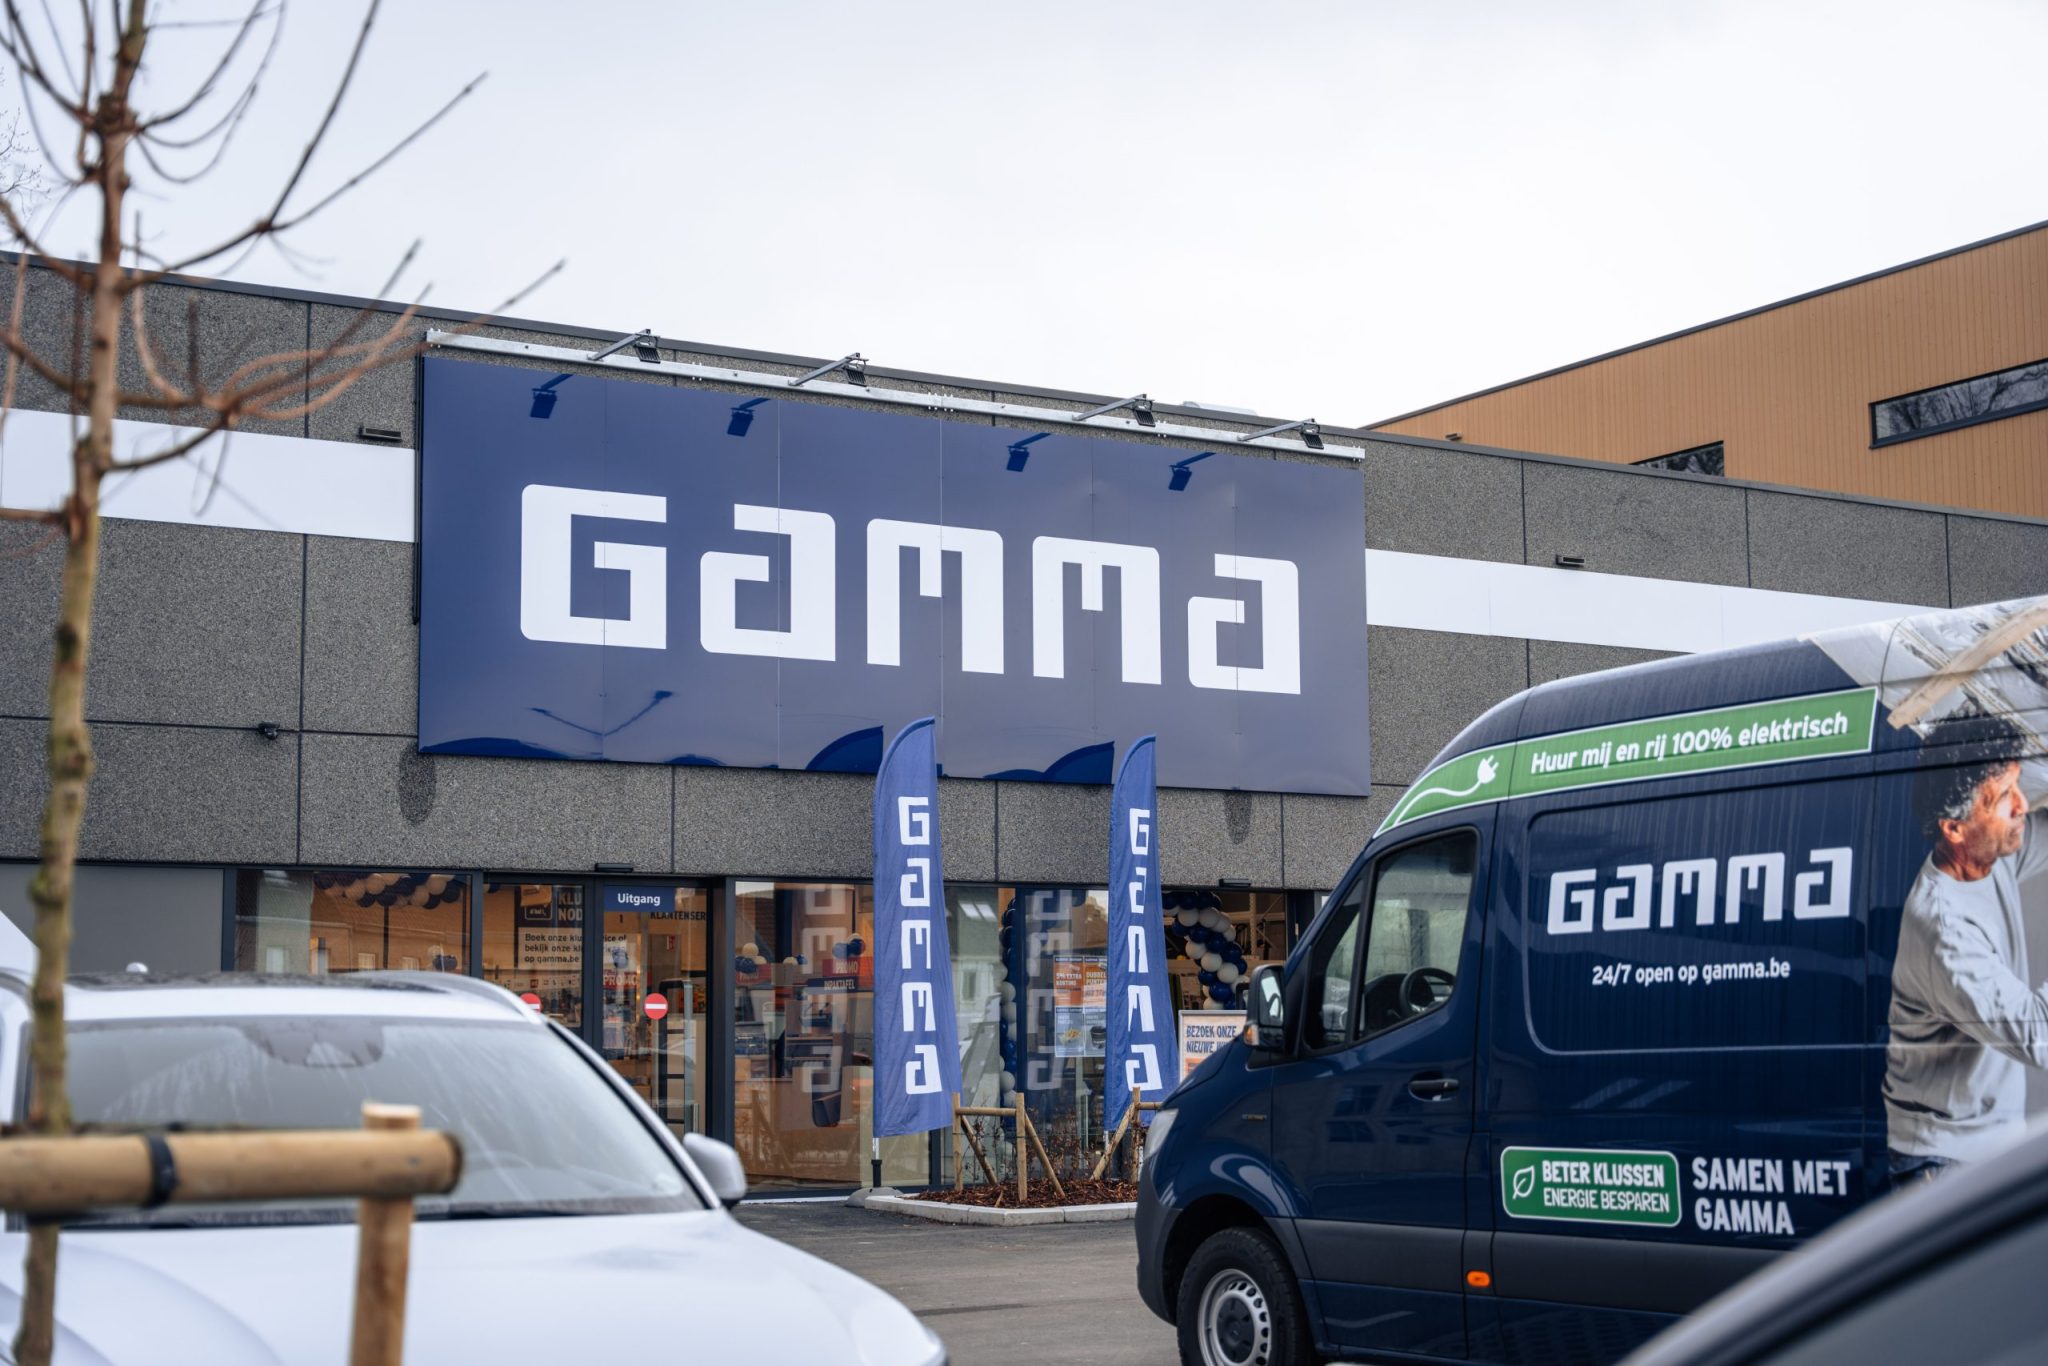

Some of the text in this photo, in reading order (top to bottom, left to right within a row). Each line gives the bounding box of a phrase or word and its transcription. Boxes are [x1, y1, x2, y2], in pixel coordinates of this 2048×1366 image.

[520, 484, 1301, 694] GAMMA
[1531, 711, 1848, 774] Huur mij en rij 100% elektrisch
[617, 893, 661, 907] Uitgang
[1547, 846, 1852, 935] GAMMA
[525, 933, 546, 942] Boek
[548, 934, 567, 942] onze
[525, 944, 549, 953] bekijk
[898, 796, 942, 1095] GAMMA
[524, 955, 535, 963] op
[1592, 957, 1791, 987] 24/7 open op gamma.be
[1186, 1025, 1237, 1038] BEZOEK ONZE
[1186, 1041, 1215, 1053] NIEUWE
[1542, 1160, 1664, 1188] BETER KLUSSEN
[1692, 1157, 1851, 1195] SAMEN MET
[1543, 1187, 1670, 1213] ENERGIE BESPAREN
[1694, 1197, 1795, 1235] GAMMA
